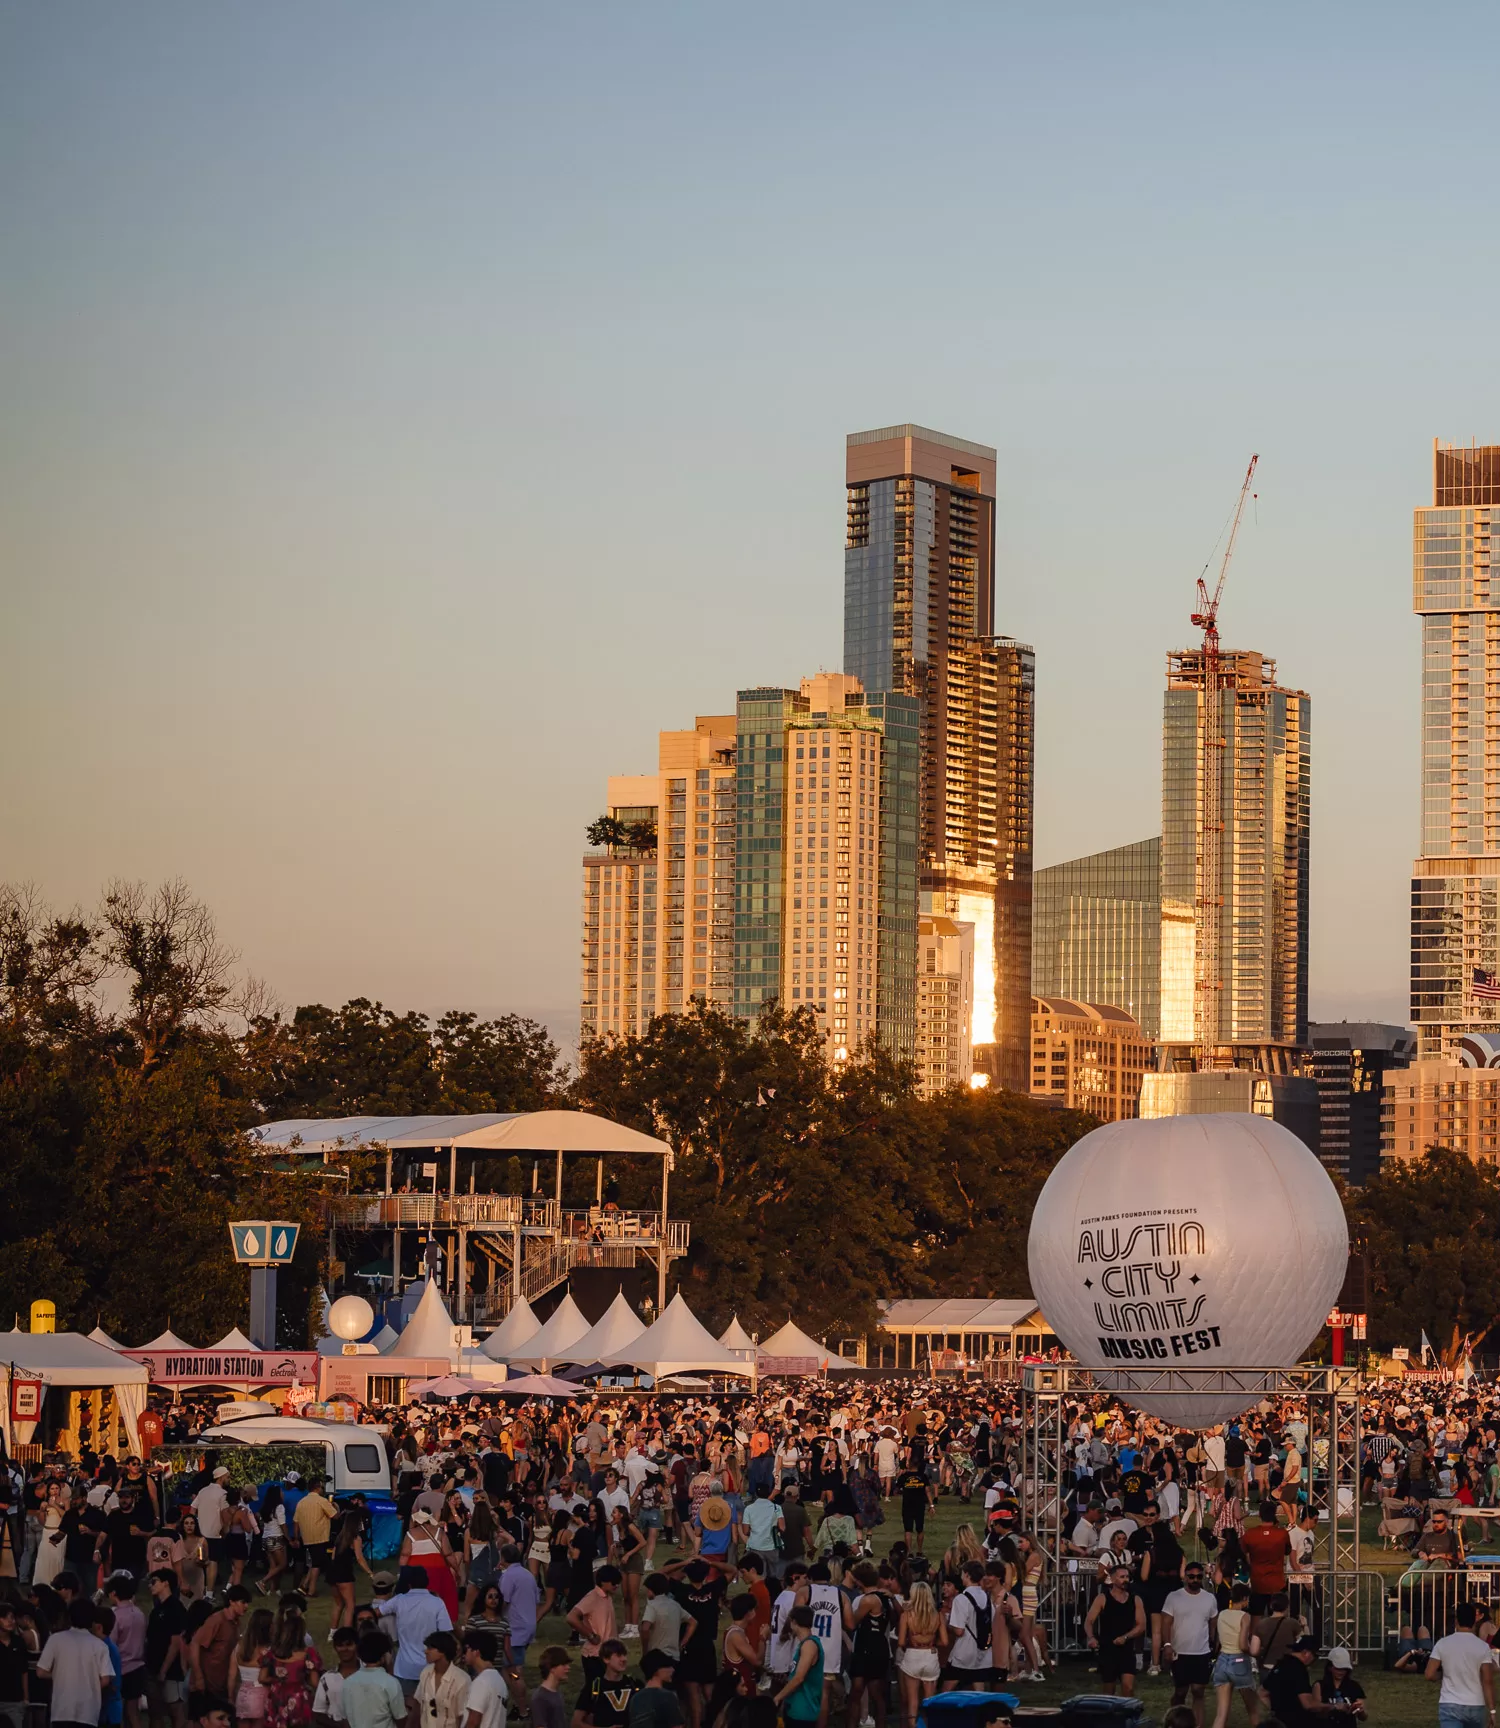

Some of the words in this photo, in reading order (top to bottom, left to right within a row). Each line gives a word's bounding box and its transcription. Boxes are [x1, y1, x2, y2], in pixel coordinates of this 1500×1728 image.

[1080, 1217, 1101, 1225] AUSTIN
[1101, 1214, 1120, 1222] PARKS
[1121, 1210, 1161, 1219] FOUNDATION
[1077, 1221, 1205, 1263] AUSTIN
[1101, 1260, 1181, 1298] CITY
[1094, 1294, 1206, 1332] LIMITS
[1097, 1336, 1168, 1359] MUSIC
[1170, 1325, 1221, 1357] FEST
[165, 1357, 220, 1377] HYDRATION
[223, 1357, 264, 1378] STATION
[1404, 1372, 1441, 1382] EMERGENCY
[814, 1614, 832, 1637] 41
[603, 1688, 632, 1712] V
